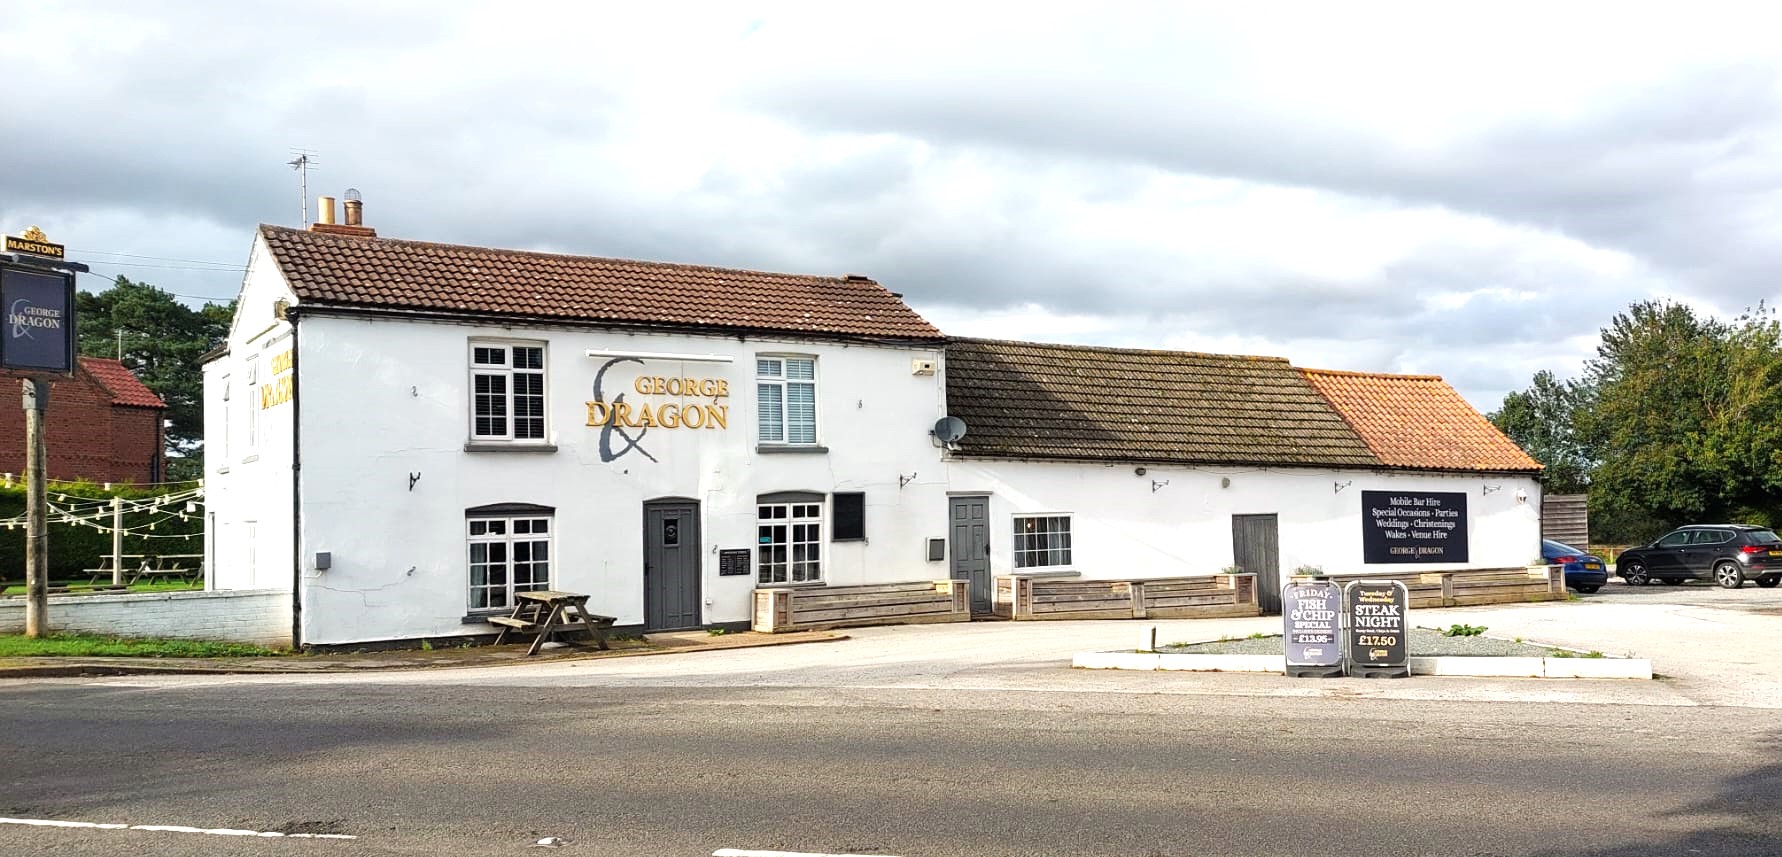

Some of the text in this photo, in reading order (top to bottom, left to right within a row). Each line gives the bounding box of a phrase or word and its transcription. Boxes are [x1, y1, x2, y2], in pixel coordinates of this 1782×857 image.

[8, 240, 62, 256] MARSTON'S
[24, 306, 61, 318] GEORGE
[8, 313, 60, 329] DRAGON
[634, 375, 729, 398] GEORGE
[585, 400, 729, 430] DRAGON
[1390, 497, 1441, 506] Mobile Bar Hire
[1372, 507, 1458, 518] Special Occasions Parties
[1376, 518, 1456, 530] Weddings Christenings
[1385, 530, 1448, 539] Wakes Venue Hire
[1292, 588, 1331, 599] FRIDAY
[1297, 600, 1327, 610] FISH
[1355, 604, 1400, 616] STEAK
[1303, 610, 1335, 620] CHIP
[1294, 621, 1331, 629] SPECIAL
[1355, 616, 1400, 628] NIGHT
[1358, 635, 1397, 646] £17.50
